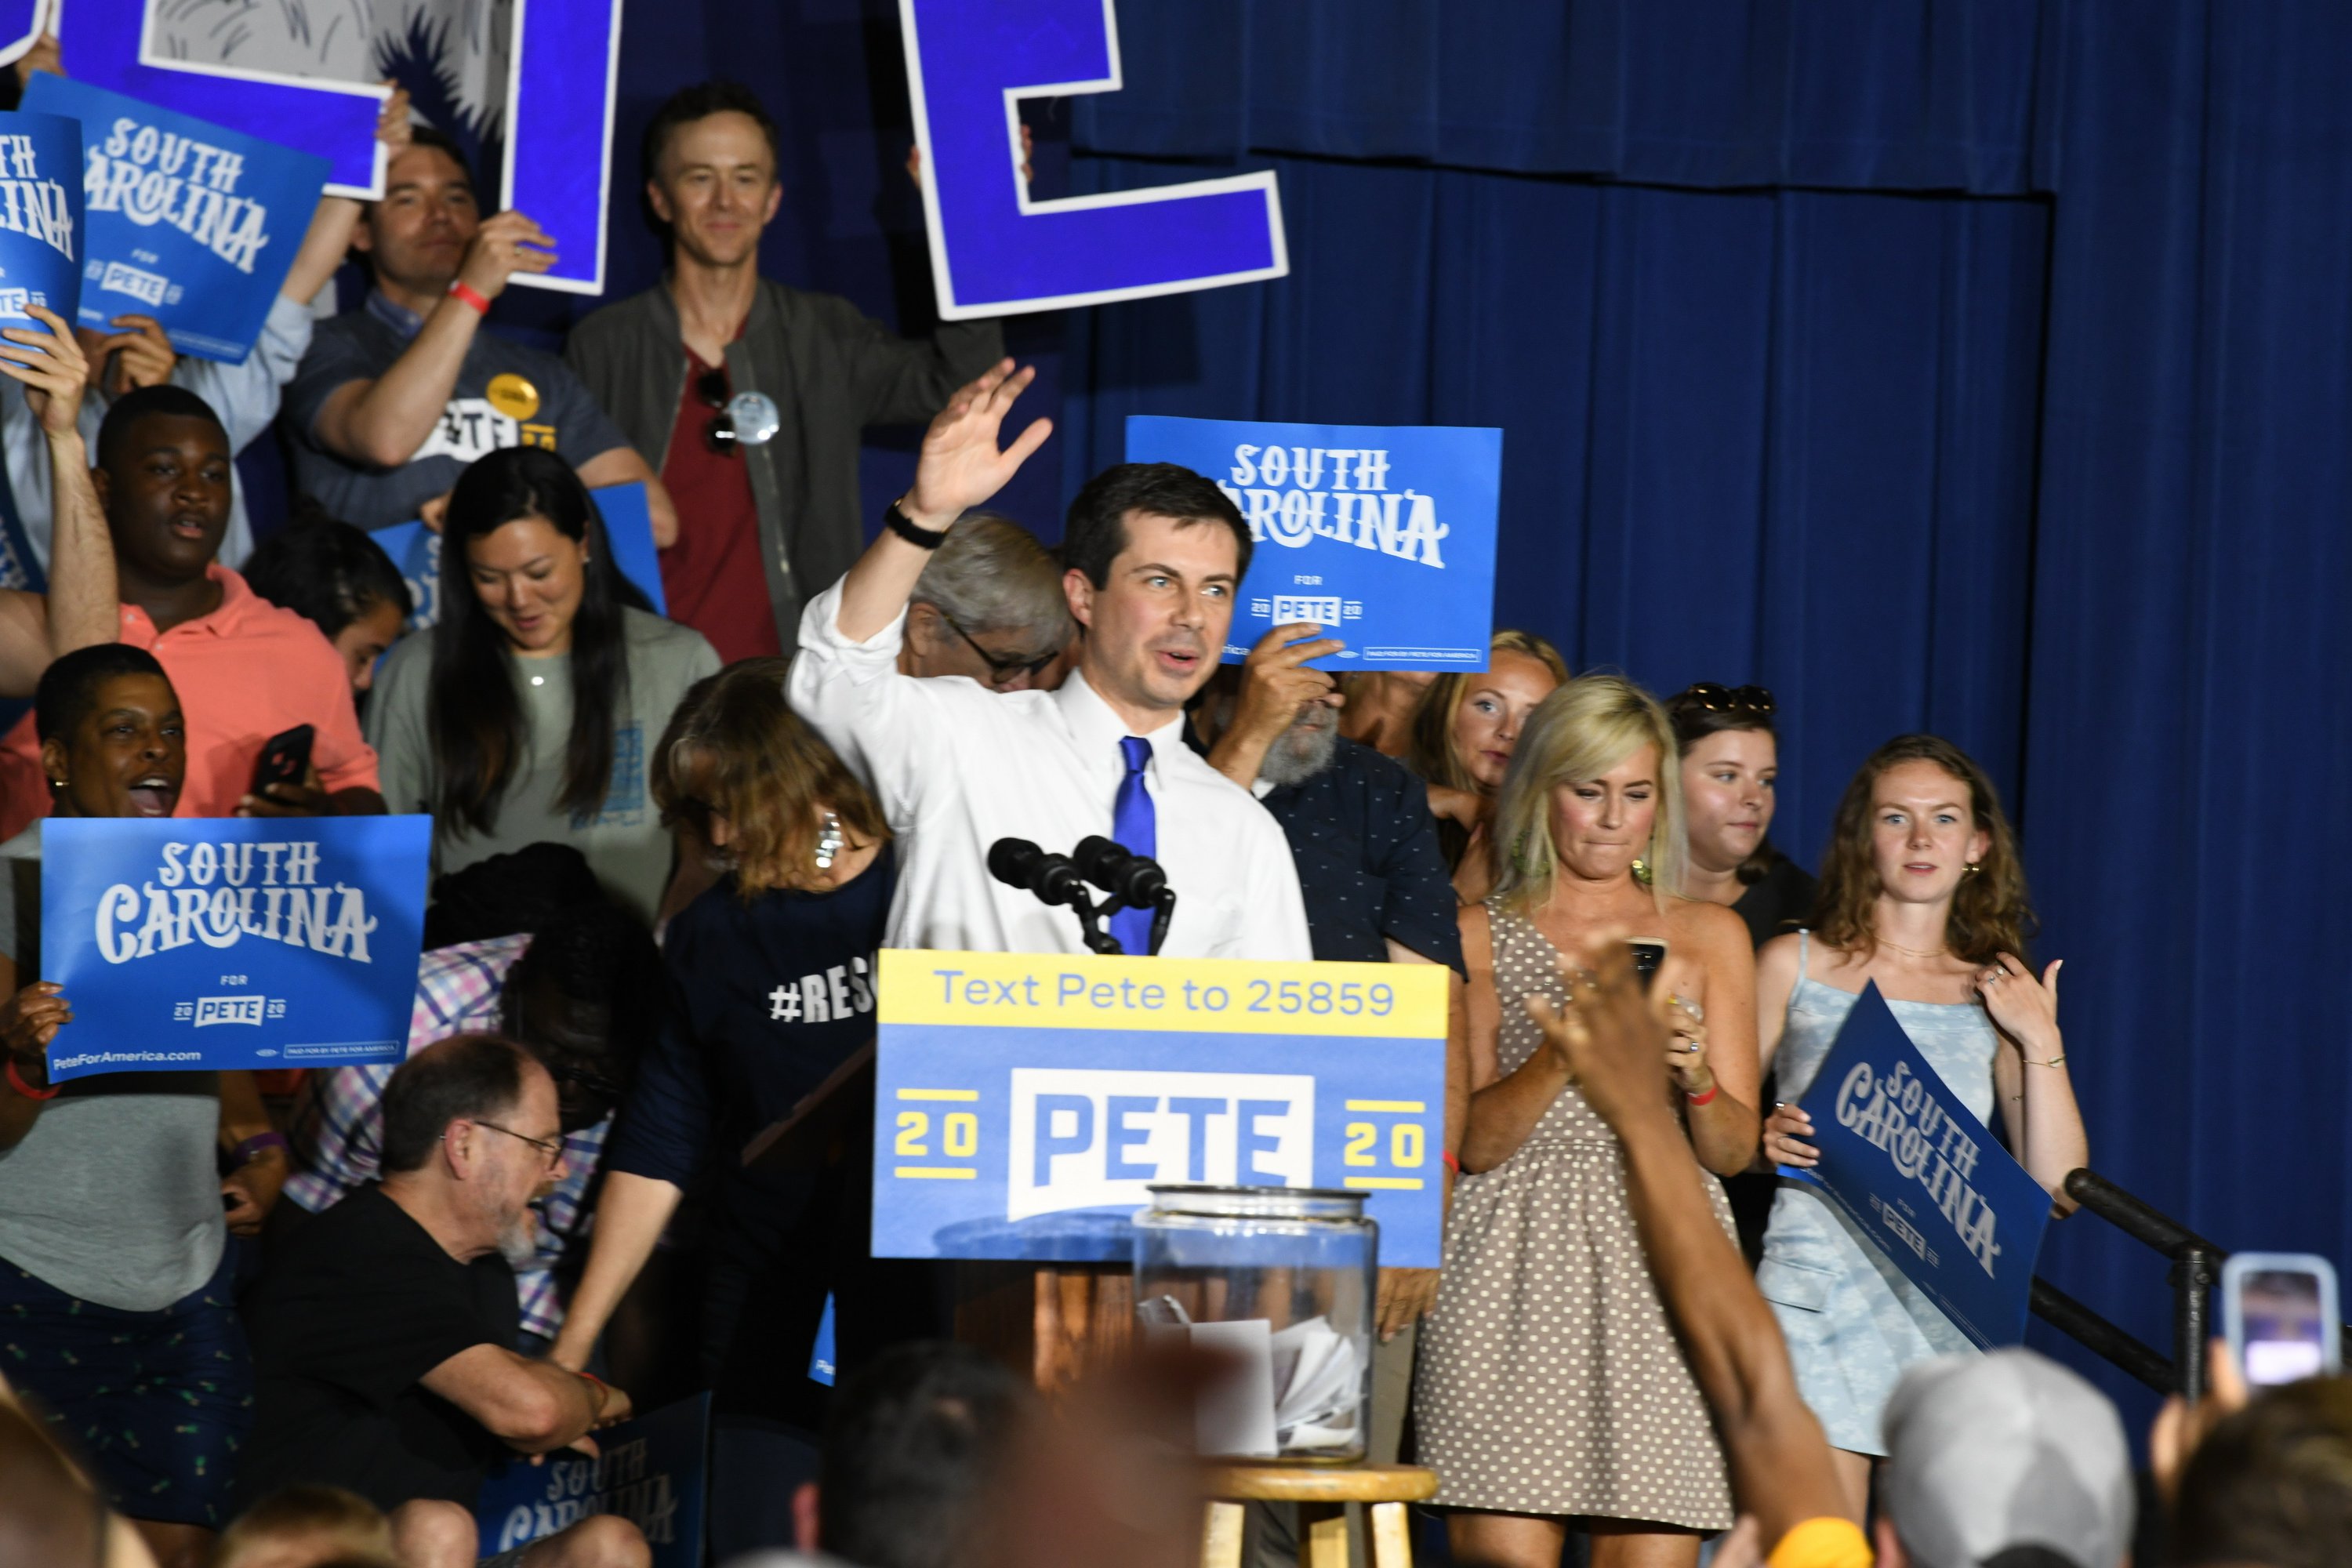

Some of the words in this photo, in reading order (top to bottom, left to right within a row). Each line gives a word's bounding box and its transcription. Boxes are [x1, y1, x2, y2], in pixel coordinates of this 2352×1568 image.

[105, 118, 244, 194] SOUTH
[83, 145, 270, 274] AROLINA
[109, 267, 161, 299] PETE
[1230, 444, 1391, 492] SOUTH
[1217, 479, 1450, 568] ROLINA
[1294, 575, 1323, 586] FOR
[1279, 600, 1334, 620] PETE
[158, 841, 321, 887] SOUTH
[95, 881, 378, 964] CAROLINA
[220, 975, 248, 985] FOR
[768, 951, 877, 1023] #RES
[933, 970, 1040, 1006] Text
[1058, 974, 1165, 1010] Pete
[1182, 980, 1229, 1011] to
[1247, 979, 1394, 1016] 25859
[173, 1006, 194, 1017] 20
[201, 1000, 260, 1022] PETE
[53, 1051, 201, 1070] PeteForAmerica.com
[895, 1110, 978, 1156] 20
[1033, 1093, 1293, 1188] PETE
[1344, 1122, 1425, 1168] 20
[1886, 1060, 1981, 1181] SOUTH
[1835, 1062, 2002, 1279] CAROLINA
[1886, 1207, 1923, 1254] PETE
[545, 1436, 648, 1501] SOUTH
